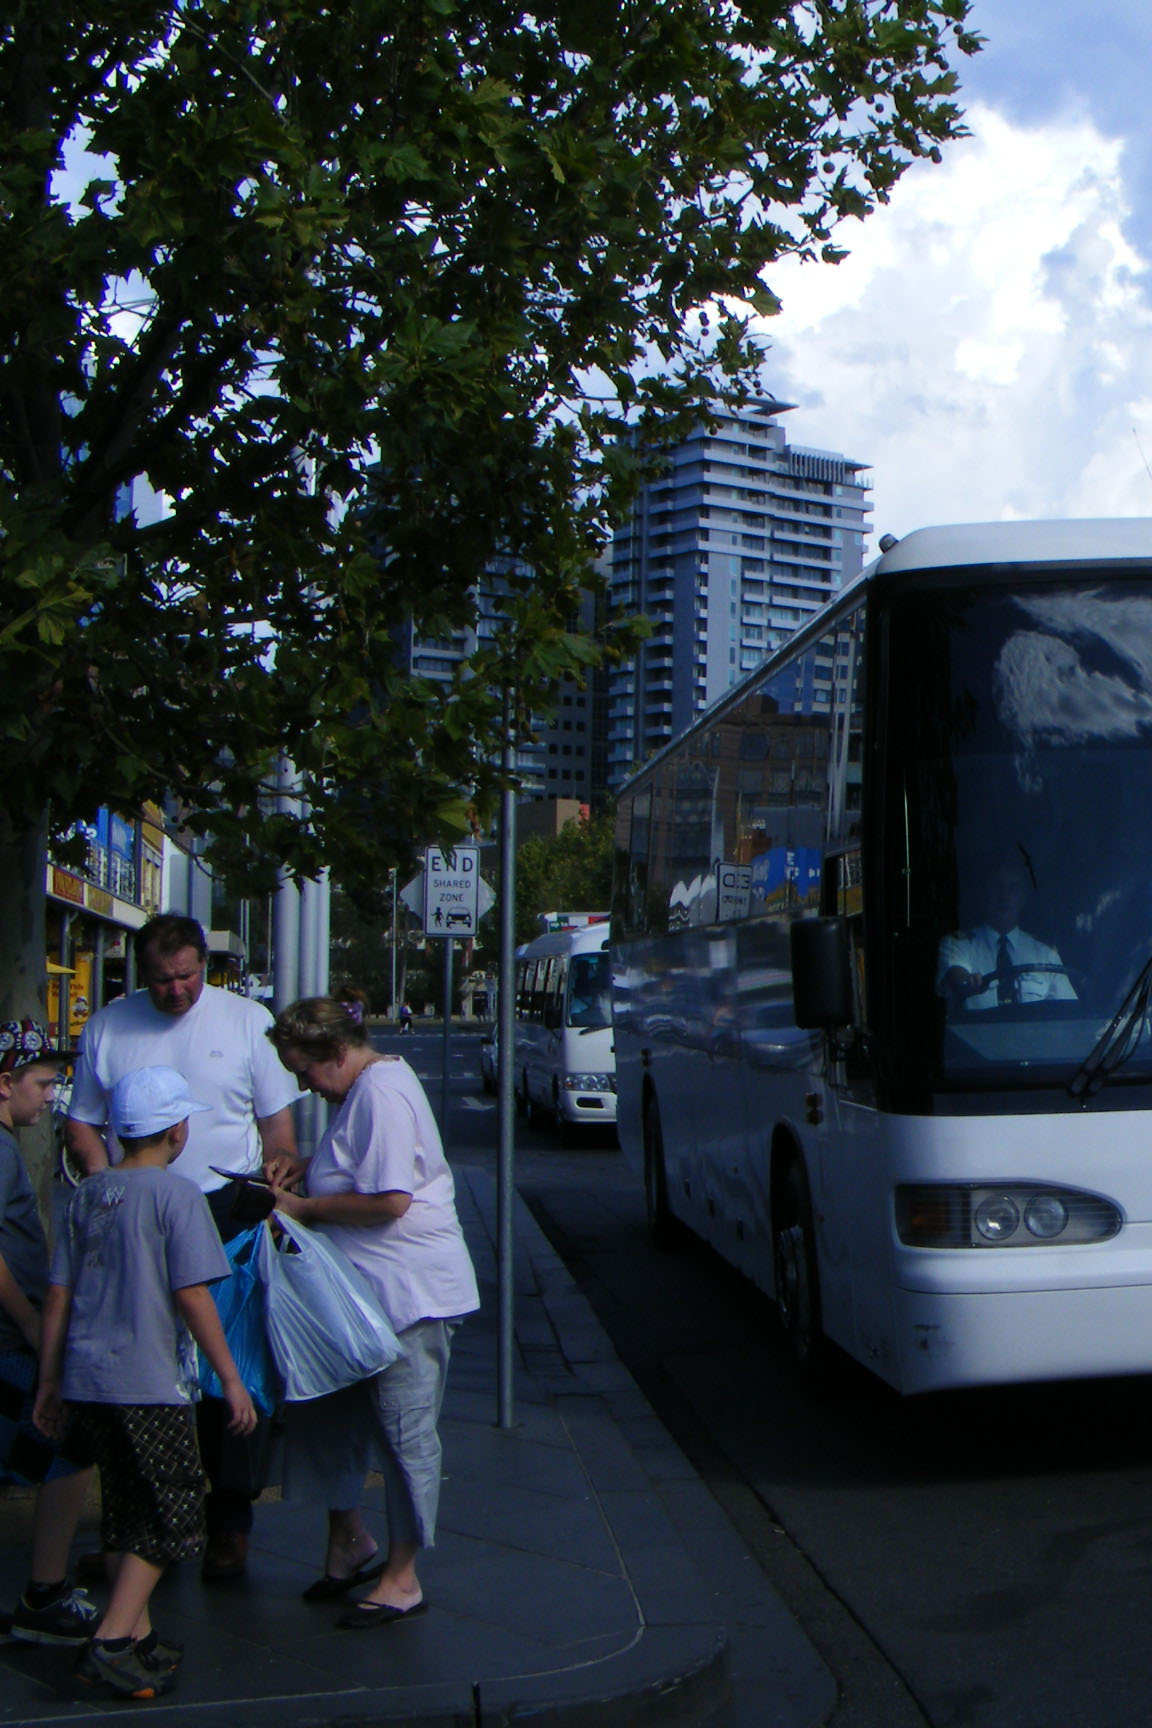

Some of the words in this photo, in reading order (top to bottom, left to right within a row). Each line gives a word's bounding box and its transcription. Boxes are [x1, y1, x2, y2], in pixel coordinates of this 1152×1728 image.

[431, 856, 473, 872] END
[433, 880, 471, 888] SHARED
[440, 893, 464, 902] ZONE
